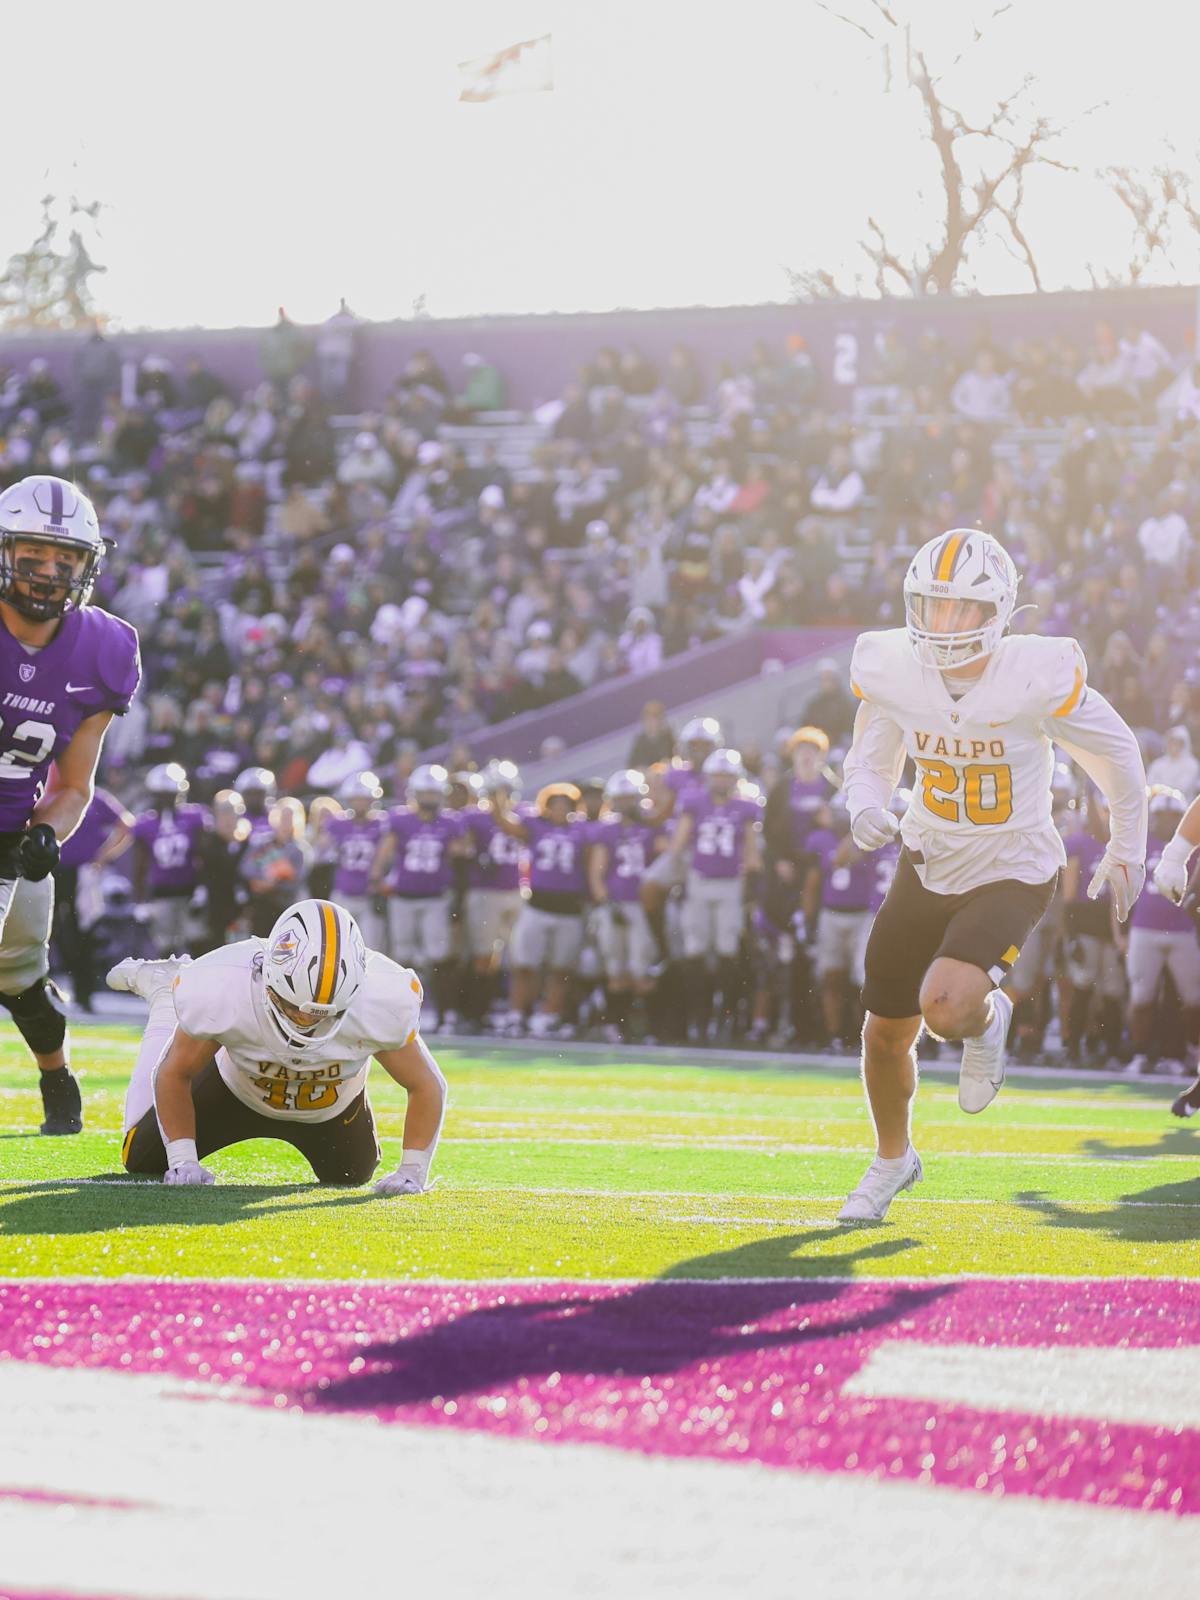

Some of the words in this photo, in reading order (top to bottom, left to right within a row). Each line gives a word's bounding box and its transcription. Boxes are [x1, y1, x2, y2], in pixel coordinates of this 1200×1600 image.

[2, 693, 56, 715] THOMAS
[914, 731, 1005, 758] VALPO
[914, 756, 1014, 826] 20
[259, 1061, 341, 1081] VALPO
